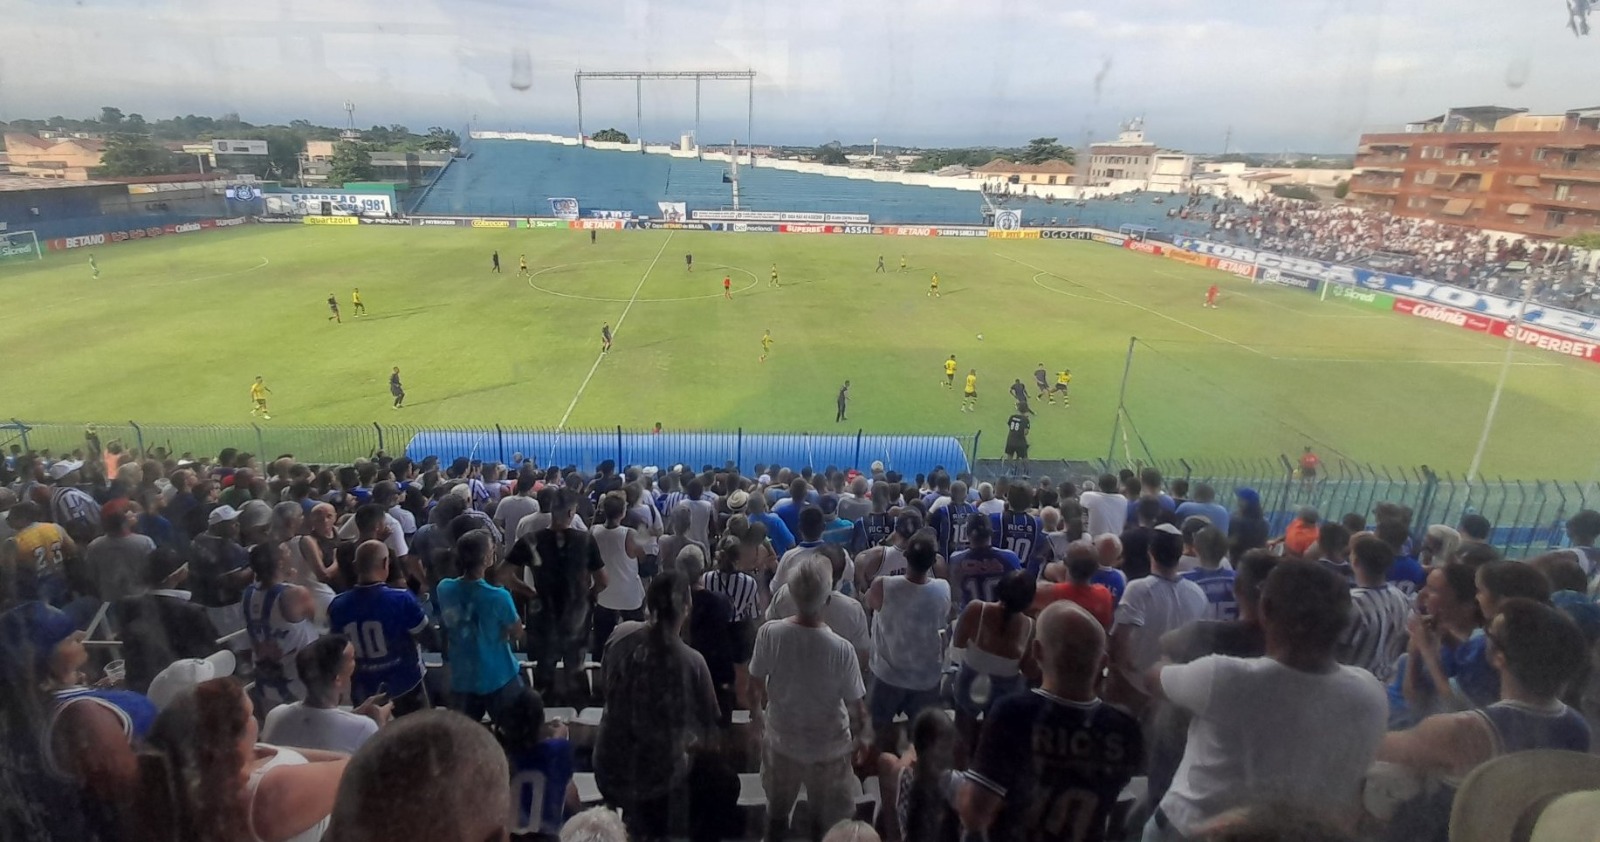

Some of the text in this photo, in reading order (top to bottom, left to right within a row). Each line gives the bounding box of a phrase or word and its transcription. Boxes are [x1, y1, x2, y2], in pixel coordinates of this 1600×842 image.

[362, 199, 386, 211] 1981
[583, 221, 616, 229] BETANO
[786, 225, 826, 233] SUPERBET
[897, 227, 930, 236] BETANO
[66, 234, 105, 248] BETANO
[1042, 230, 1091, 239] OGOCHI
[2, 245, 32, 256] Sicredi
[1194, 240, 1358, 283] TORCIDA
[1217, 259, 1251, 276] BETANO
[1344, 287, 1376, 303] Sicredi
[1504, 324, 1597, 358] SUPERBET
[1006, 536, 1032, 567] 10
[343, 620, 388, 659] 10
